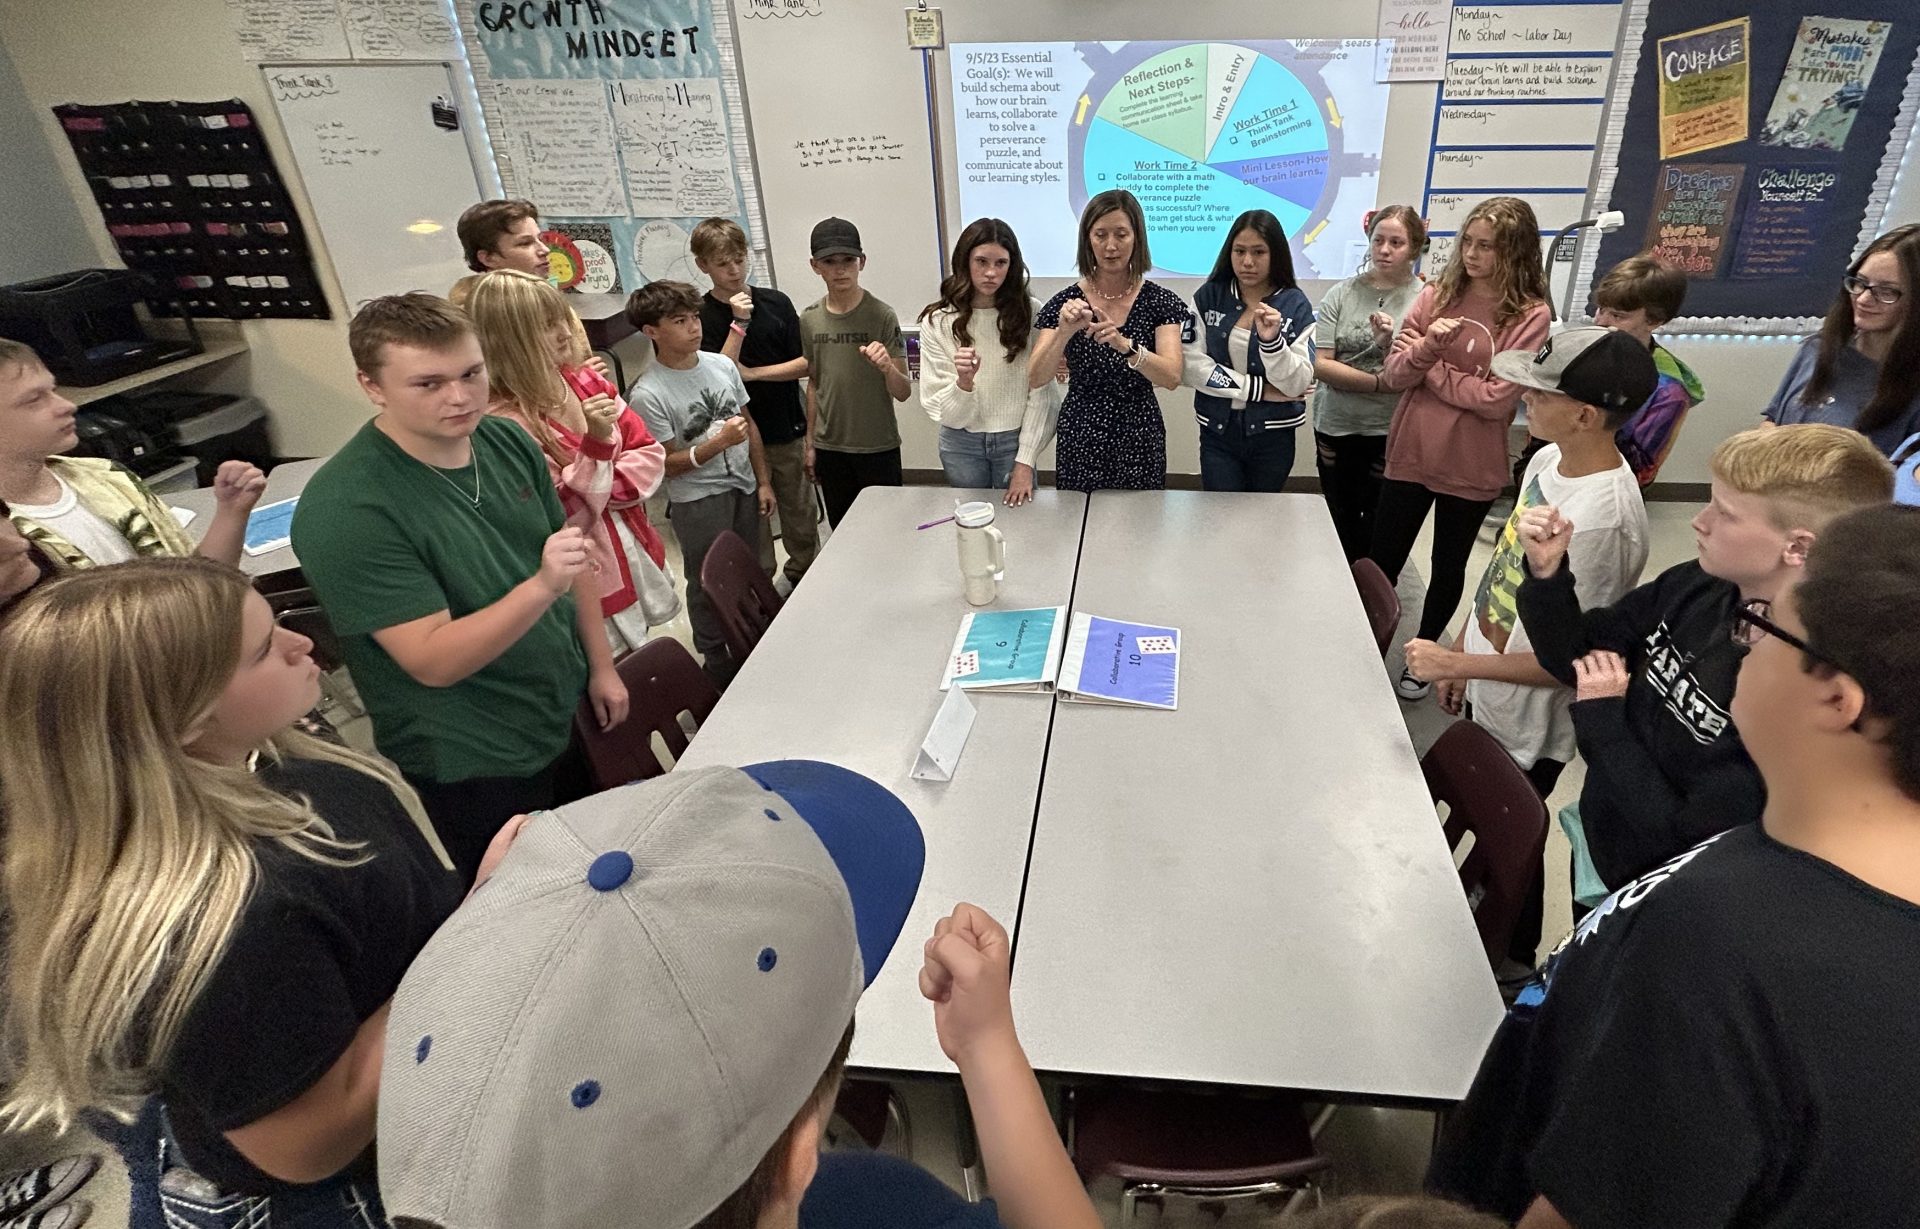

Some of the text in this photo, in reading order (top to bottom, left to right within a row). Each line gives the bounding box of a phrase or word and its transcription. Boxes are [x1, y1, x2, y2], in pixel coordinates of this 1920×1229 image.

[1385, 12, 1446, 29] hello
[1458, 28, 1572, 43] No School Labor Day
[565, 26, 699, 59] MINDSET
[1345, 39, 1371, 47] seats
[966, 50, 1052, 64] 9/5/23 Essential
[1665, 38, 1741, 81] COURAGE
[966, 67, 1053, 80] Goal(s): We will
[1123, 58, 1194, 86] Reflection &
[1495, 61, 1508, 74] We
[1512, 62, 1528, 73] will
[1533, 62, 1542, 73] be
[1545, 62, 1561, 73] able
[1565, 62, 1572, 72] to
[1213, 53, 1244, 120] Intro & Entry
[1446, 75, 1463, 86] how
[1465, 78, 1476, 86] our
[1502, 75, 1523, 84] learns
[1526, 75, 1539, 84] and
[1544, 74, 1562, 84] build
[1567, 74, 1596, 85] schema
[961, 82, 1060, 92] build schema about
[1128, 76, 1195, 100] Next Steps-
[1446, 87, 1471, 97] around
[1474, 88, 1485, 96] our
[1487, 86, 1514, 97] thinking
[976, 95, 998, 106] how
[1020, 95, 1046, 105] brain
[966, 108, 1058, 120] learns, collaborate
[1233, 98, 1297, 131] Work Time 1
[989, 122, 1000, 132] to
[1002, 121, 1028, 132] solve
[1247, 114, 1294, 137] Think Tank
[1251, 118, 1312, 148] Brainstorming
[651, 140, 678, 156] YET
[811, 138, 830, 146] think
[980, 136, 1046, 148] perseverance
[986, 147, 1041, 160] puzzle, and
[965, 160, 1063, 170] communicate about
[1134, 160, 1198, 170] Work Time 2
[1242, 154, 1328, 174] Mini Lesson- How
[968, 172, 1060, 184] our learning styles.
[1243, 168, 1322, 186] our brain learns.
[1664, 168, 1734, 191] Dreams
[1759, 168, 1835, 192] Challenge
[1155, 184, 1194, 192] complete
[1174, 194, 1200, 202] puzzle
[1156, 204, 1230, 212] successful? Where
[1170, 216, 1182, 224] get
[1184, 214, 1205, 222] stuck
[1215, 214, 1234, 222] what
[585, 254, 608, 271] proof
[813, 332, 868, 344] JIU-JITSU
[1210, 370, 1232, 388] BOSS
[1008, 619, 1028, 670] Collaborative Group
[1110, 632, 1126, 685] Collaborative Group
[1129, 654, 1142, 666] 10
[1646, 630, 1728, 736] ARATE
